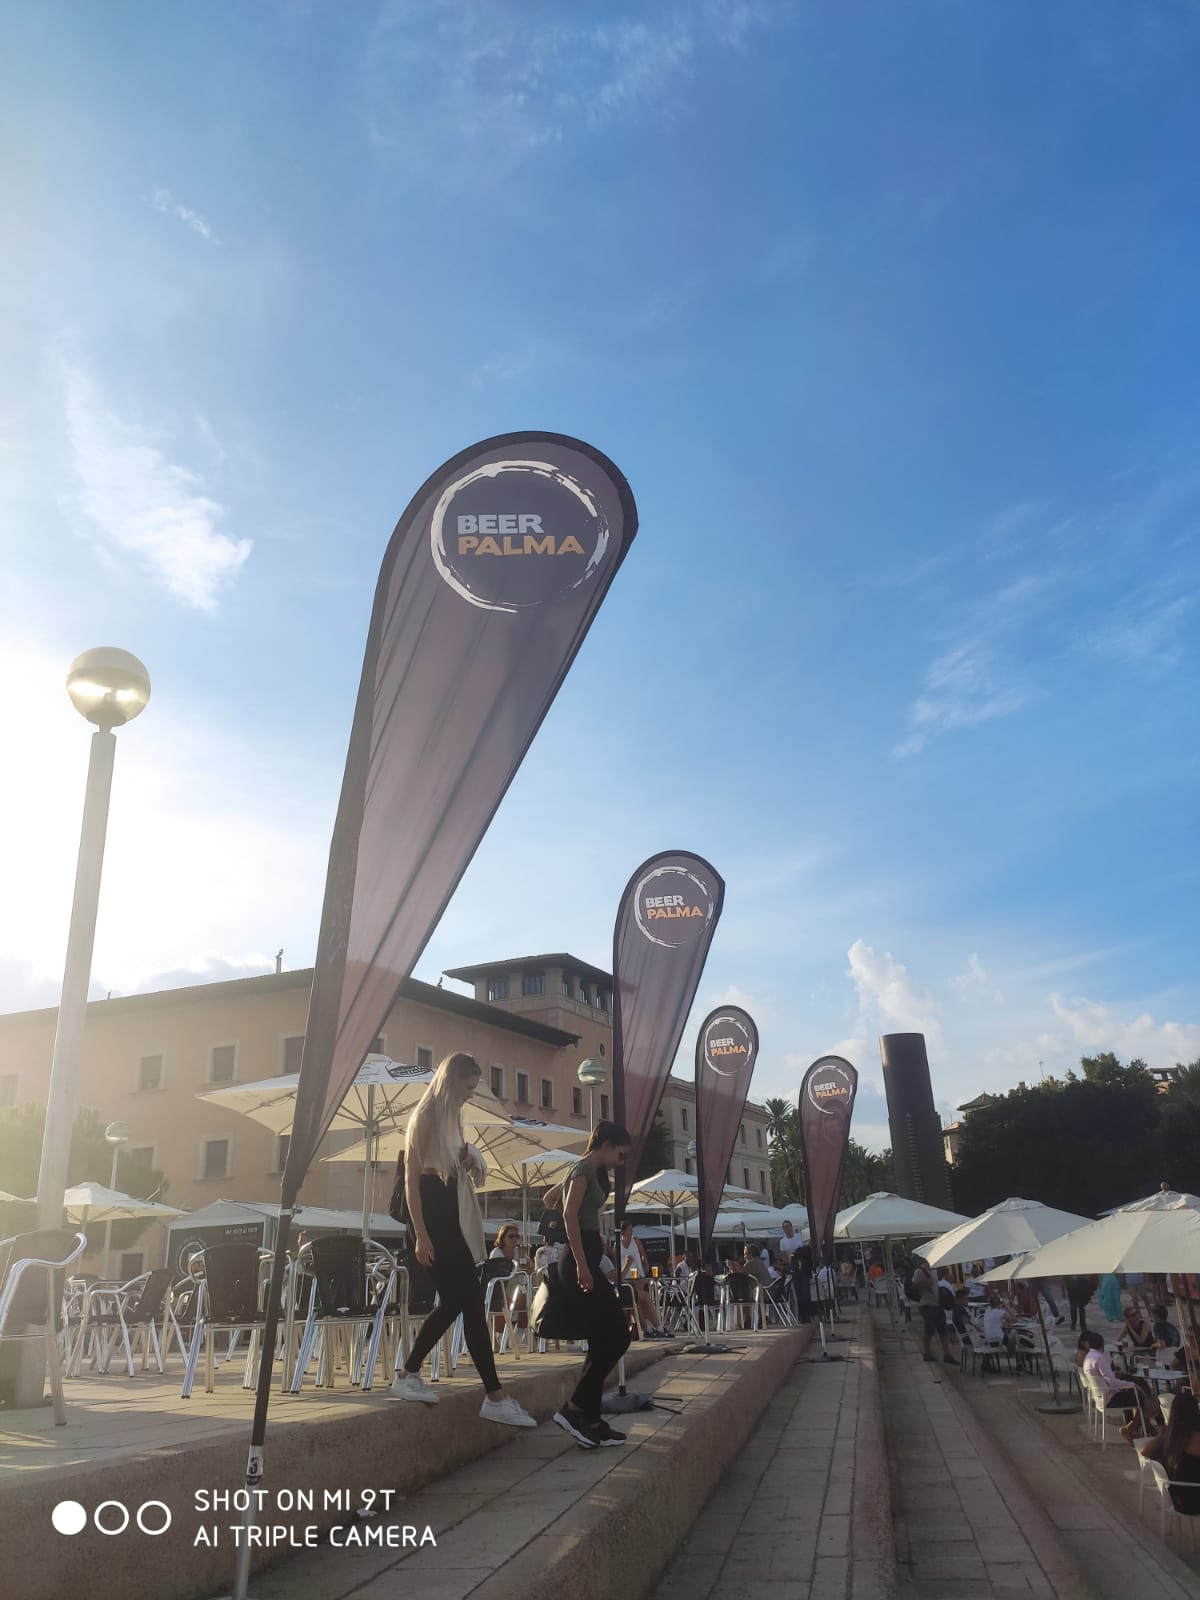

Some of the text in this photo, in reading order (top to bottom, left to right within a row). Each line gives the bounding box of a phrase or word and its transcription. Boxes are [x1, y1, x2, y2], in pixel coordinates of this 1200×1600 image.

[457, 514, 545, 535] BEER
[458, 535, 586, 556] PALMA
[645, 895, 685, 909] BEER
[647, 906, 704, 920] PALMA
[710, 1037, 735, 1048] BEER
[711, 1044, 747, 1057] PALMA
[814, 1082, 837, 1092] BEER
[816, 1087, 849, 1099] PALMA
[249, 1457, 259, 1474] 3
